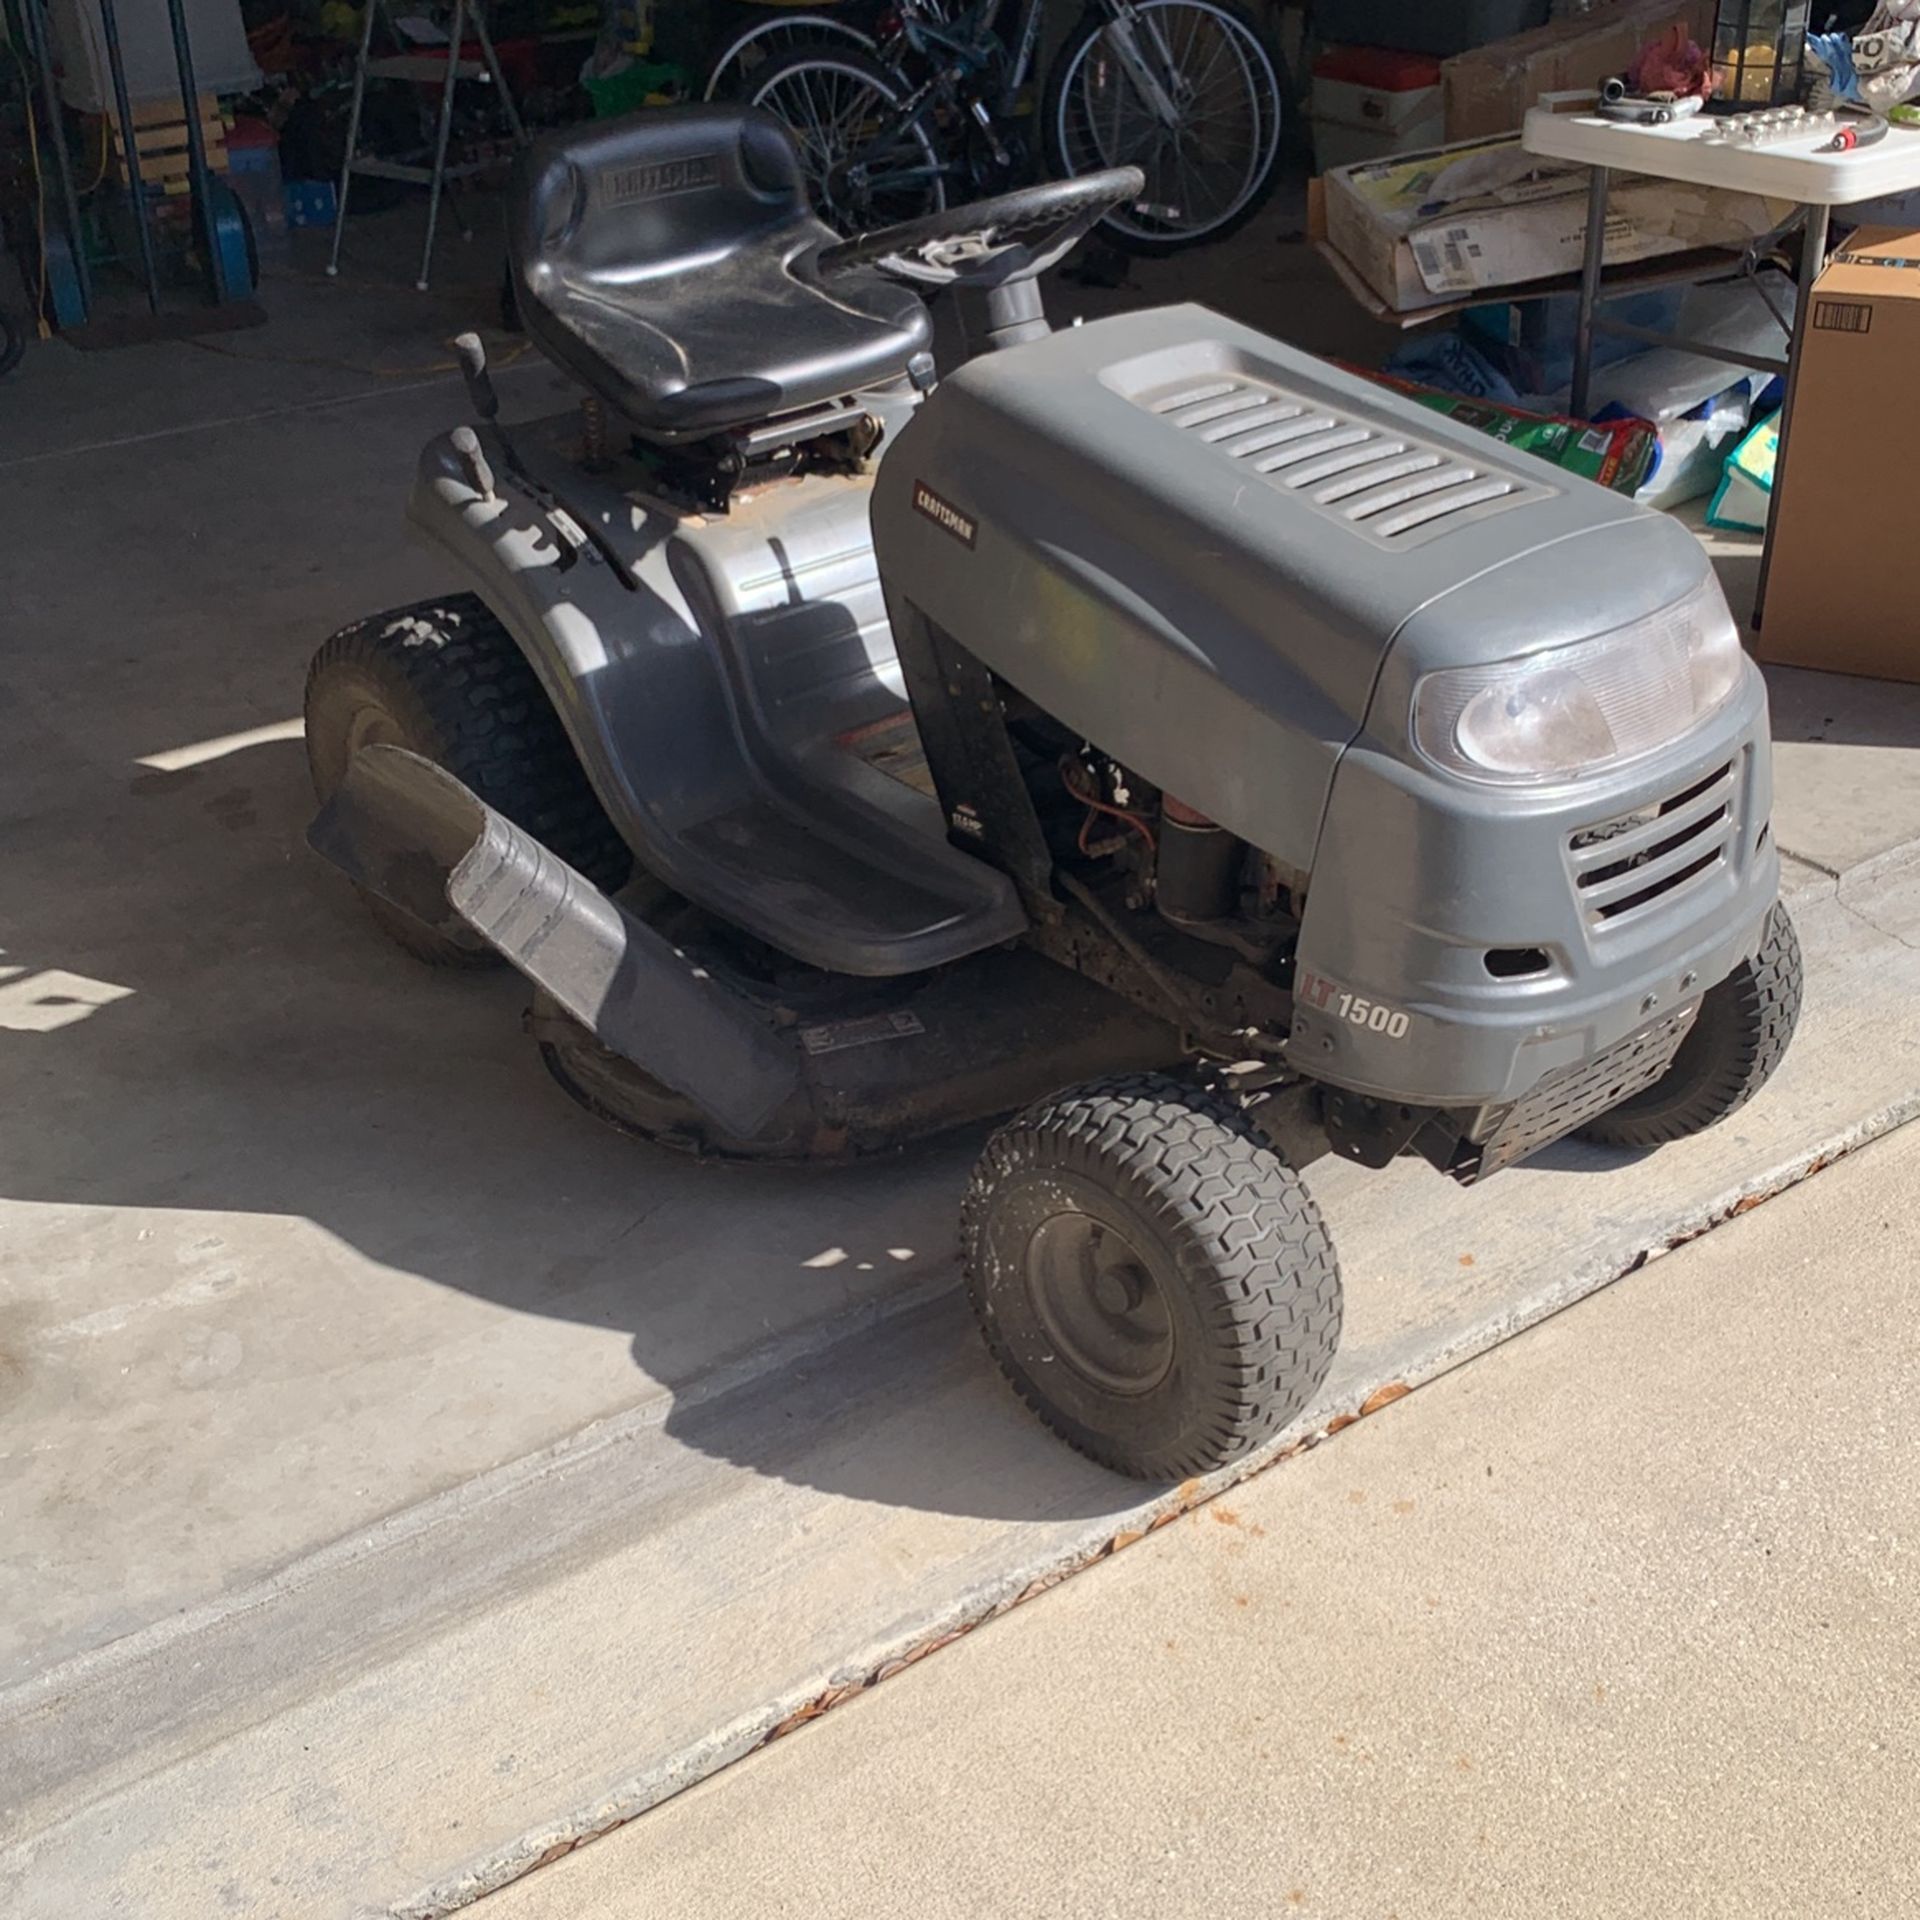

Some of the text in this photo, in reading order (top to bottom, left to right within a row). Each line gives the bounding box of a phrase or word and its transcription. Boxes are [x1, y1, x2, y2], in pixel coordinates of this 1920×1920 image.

[918, 489, 973, 540] CRAFTSMAN
[1300, 973, 1410, 1039] LT 1500
